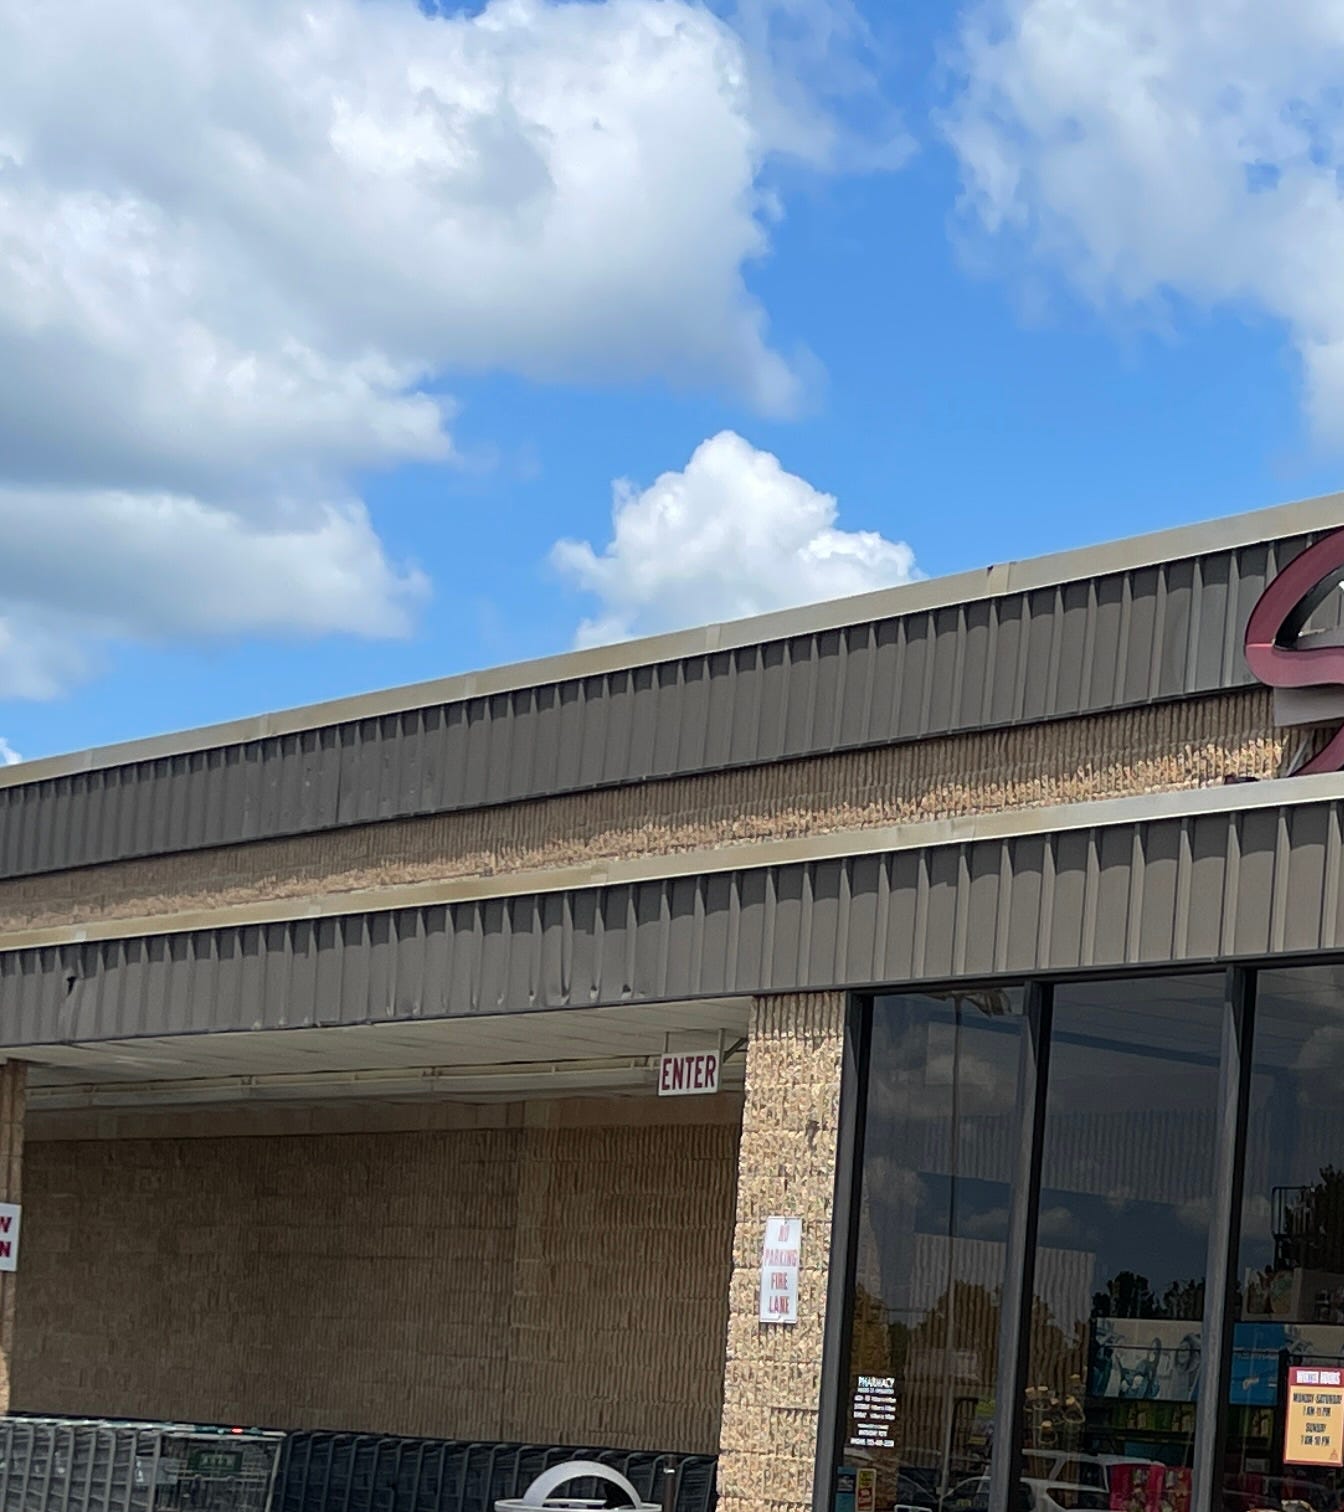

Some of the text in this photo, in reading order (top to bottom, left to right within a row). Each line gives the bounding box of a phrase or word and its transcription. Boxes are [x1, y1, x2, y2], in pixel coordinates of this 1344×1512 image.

[662, 1055, 716, 1090] ENTER
[771, 1272, 788, 1290] FIRE
[769, 1295, 789, 1313] LANE
